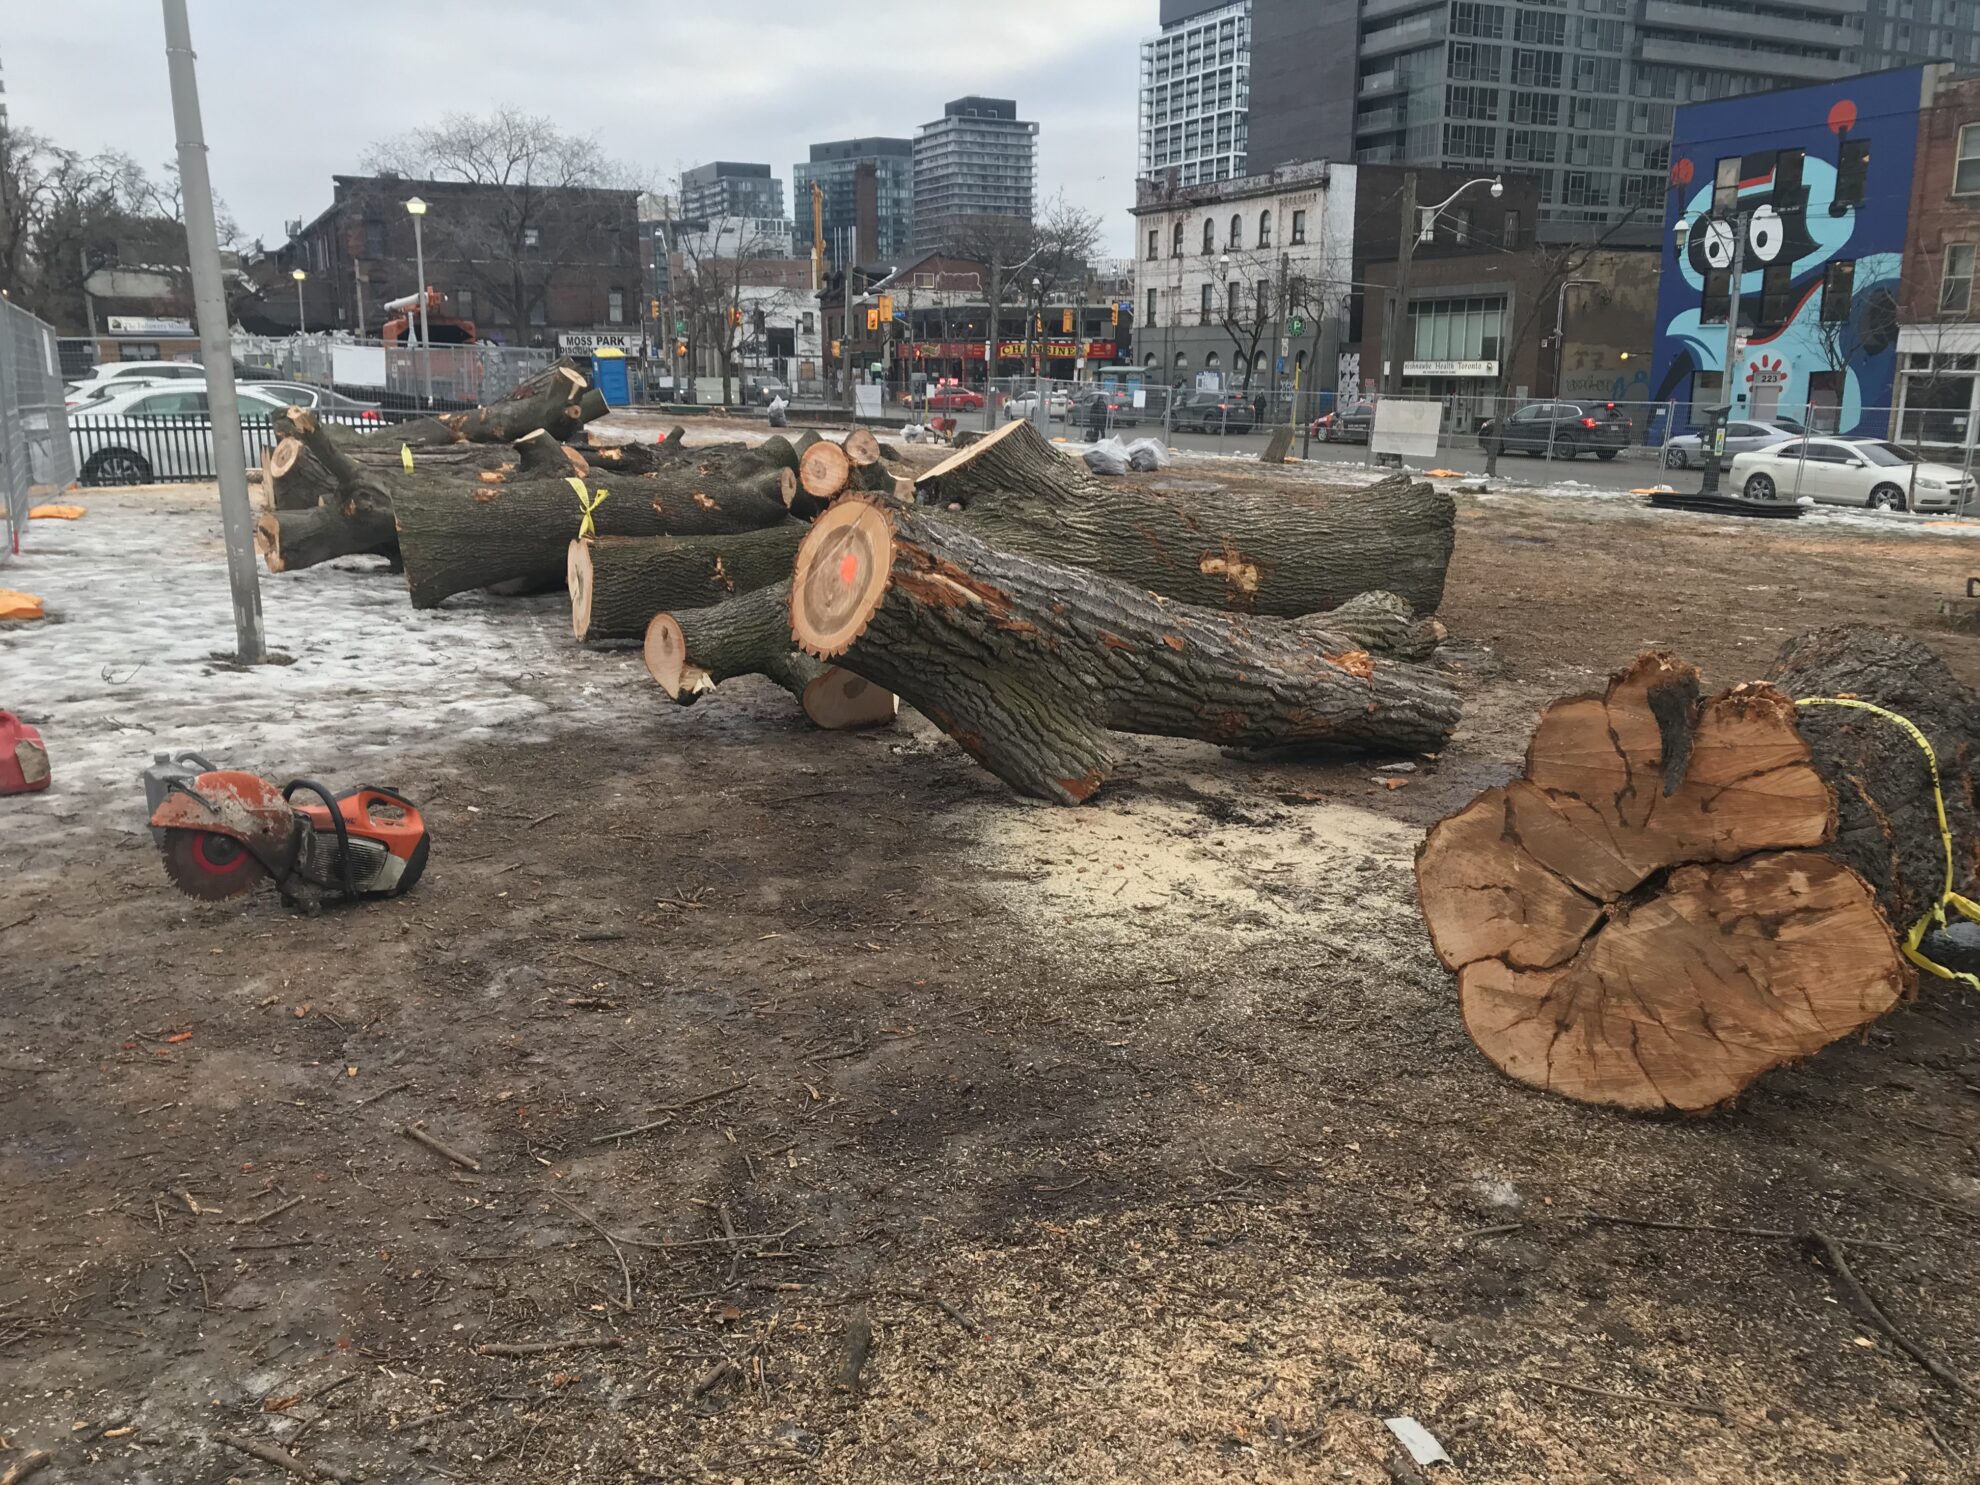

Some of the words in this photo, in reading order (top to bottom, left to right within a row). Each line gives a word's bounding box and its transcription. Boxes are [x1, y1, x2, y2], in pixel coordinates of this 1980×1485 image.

[566, 336, 592, 346] MOSS
[597, 336, 625, 346] PARK
[1458, 362, 1481, 370] Toronto
[1762, 375, 1777, 383] 223
